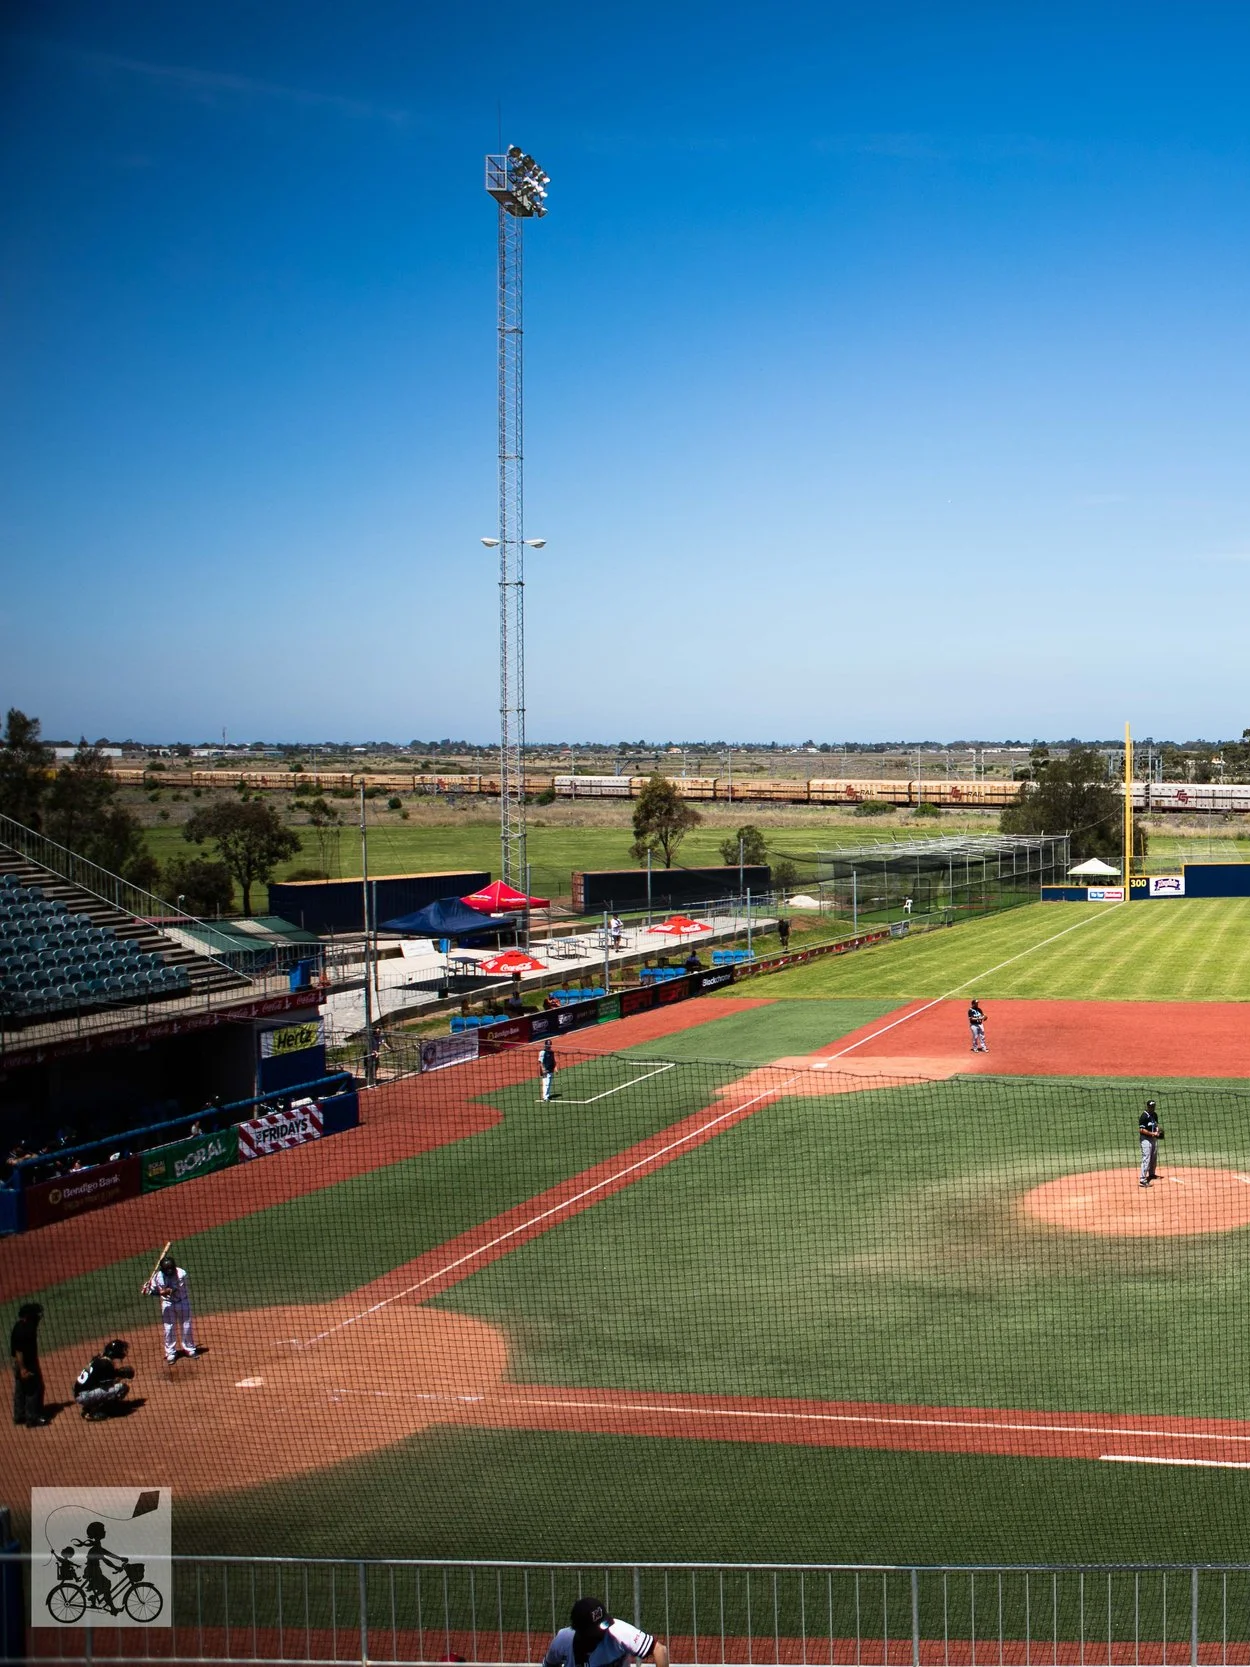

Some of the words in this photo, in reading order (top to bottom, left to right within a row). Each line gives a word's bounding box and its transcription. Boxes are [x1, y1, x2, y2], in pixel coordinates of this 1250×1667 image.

[1130, 879, 1146, 888] 300
[277, 1030, 312, 1049] Hertz
[262, 1118, 308, 1143] FRIDAYS
[174, 1139, 226, 1178] BORAL
[63, 1180, 98, 1198] Bendigo
[98, 1173, 121, 1187] Bank
